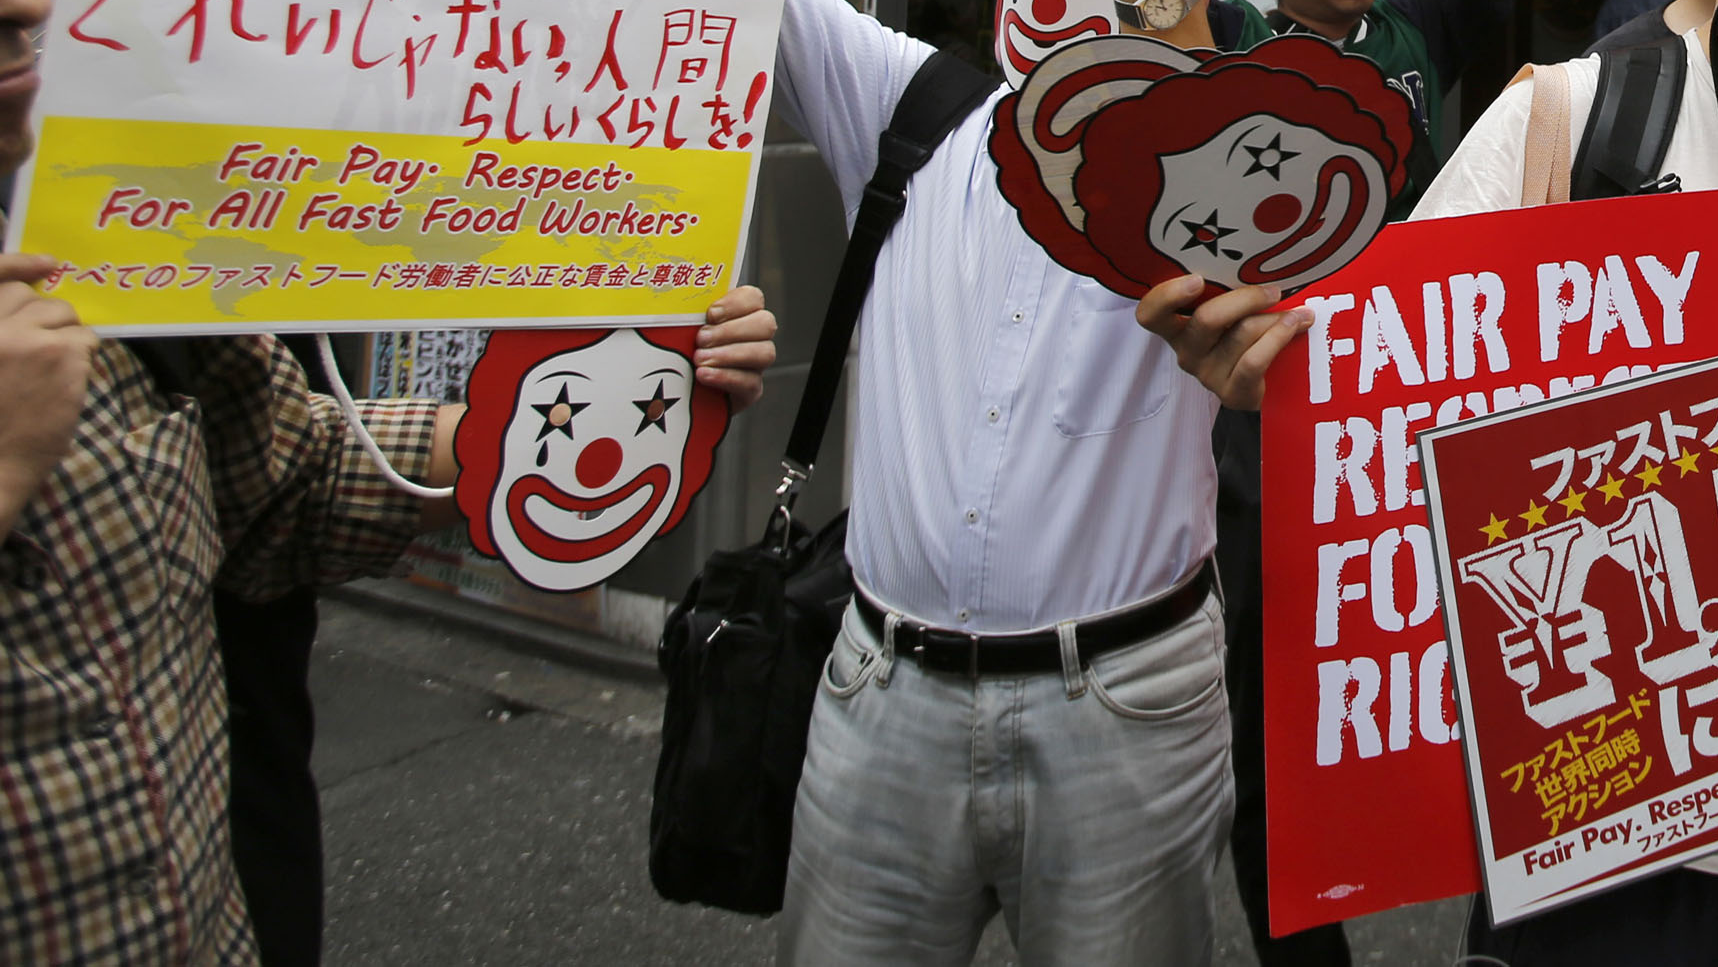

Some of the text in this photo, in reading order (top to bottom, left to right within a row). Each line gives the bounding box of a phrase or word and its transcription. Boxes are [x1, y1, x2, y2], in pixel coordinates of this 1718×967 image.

[218, 143, 319, 183] Fair
[97, 187, 191, 229] For
[206, 189, 286, 229] All
[298, 192, 402, 231] Fast
[420, 196, 528, 234] Food
[1306, 273, 1511, 407] FAIR
[1536, 250, 1701, 362] PAY
[1500, 687, 1652, 795] ファストフード
[1535, 726, 1641, 810] 世界同時
[1541, 755, 1653, 836] アクション
[1523, 841, 1575, 876] Fair
[1581, 818, 1642, 852] Pay.
